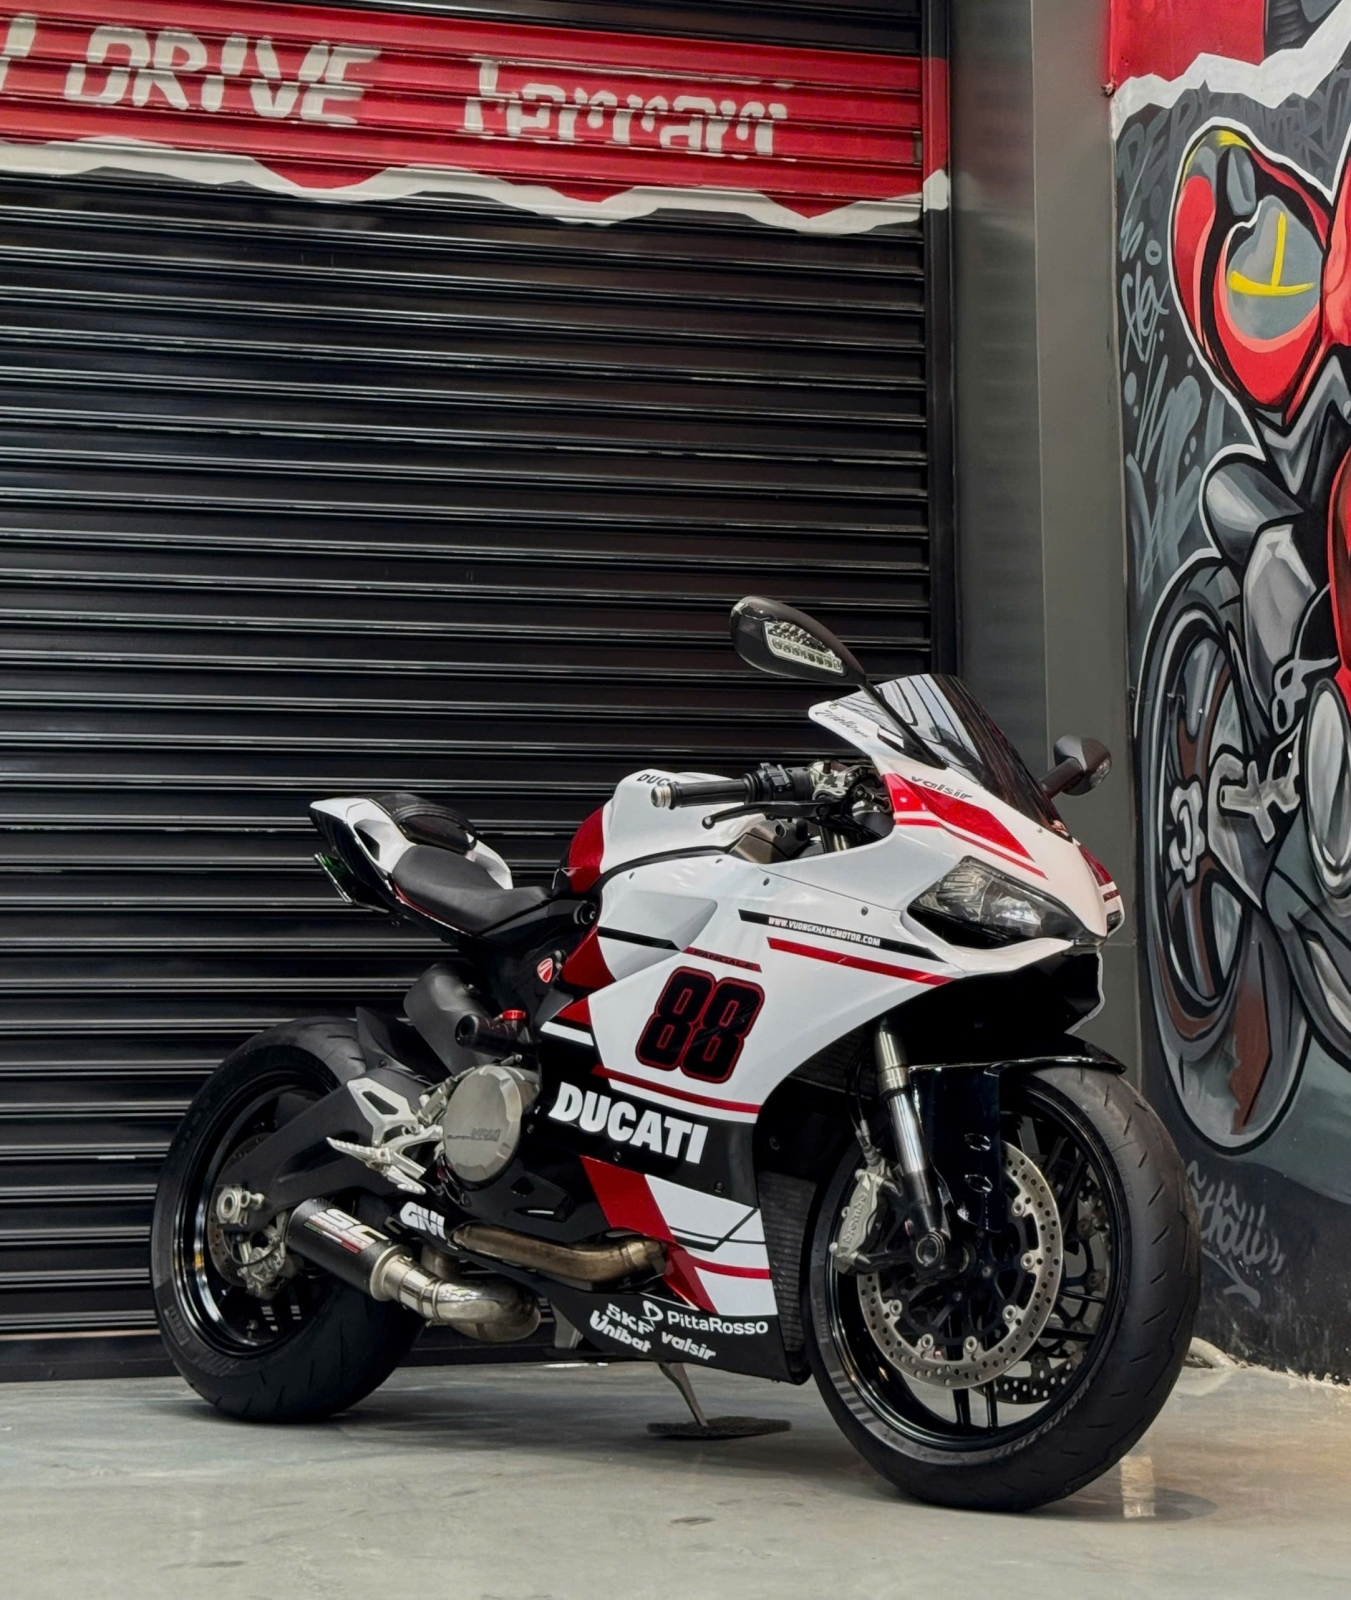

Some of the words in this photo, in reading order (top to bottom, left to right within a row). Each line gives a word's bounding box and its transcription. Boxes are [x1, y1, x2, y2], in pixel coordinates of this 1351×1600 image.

[63, 25, 382, 127] DRIVE
[456, 53, 797, 162] Ferrari
[911, 775, 974, 799] valsir
[768, 916, 881, 947] WWW.VUONGKHANGMOTOR.COM
[635, 966, 765, 1084] 88
[548, 1081, 709, 1164] DUCATI
[589, 1309, 652, 1354] Unibat
[605, 1303, 655, 1335] SKF
[667, 1310, 769, 1335] PittaRosso
[661, 1331, 717, 1361] valsir
